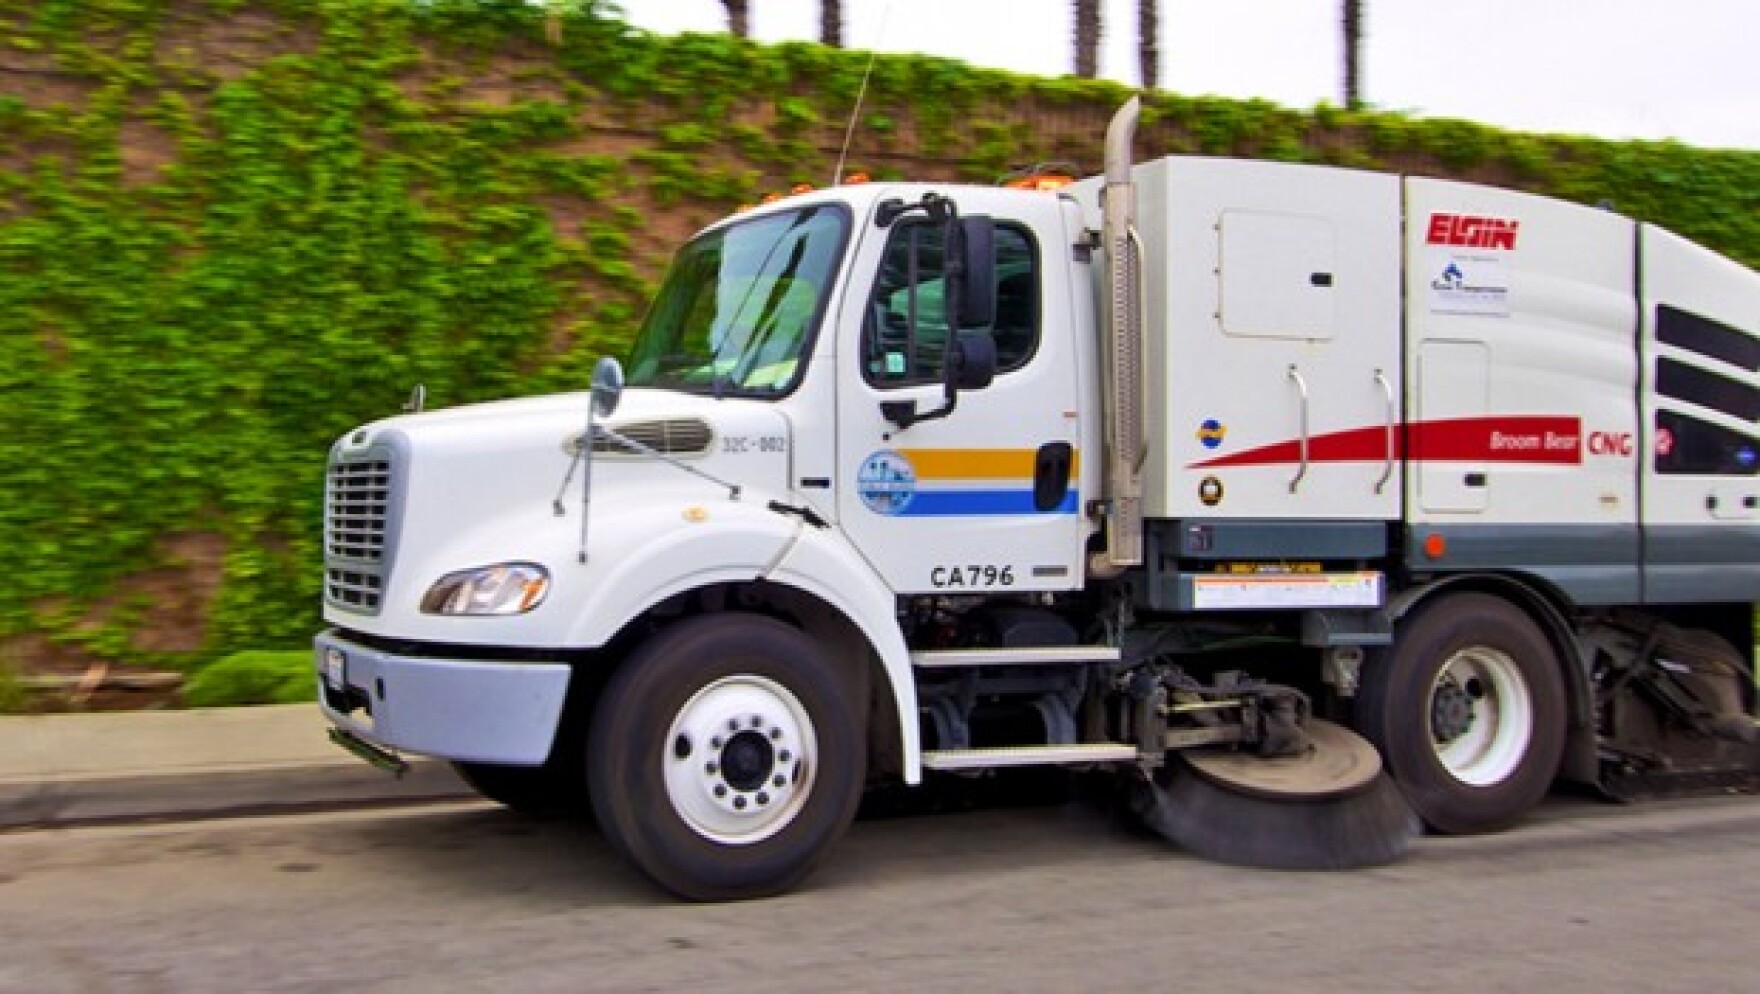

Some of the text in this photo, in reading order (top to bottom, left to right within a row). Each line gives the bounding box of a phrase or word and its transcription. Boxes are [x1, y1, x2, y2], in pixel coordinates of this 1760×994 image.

[1426, 212, 1519, 250] ELGIN
[1490, 431, 1579, 450] Broom Bear
[1587, 431, 1633, 456] CNG
[930, 564, 1014, 588] CA796
